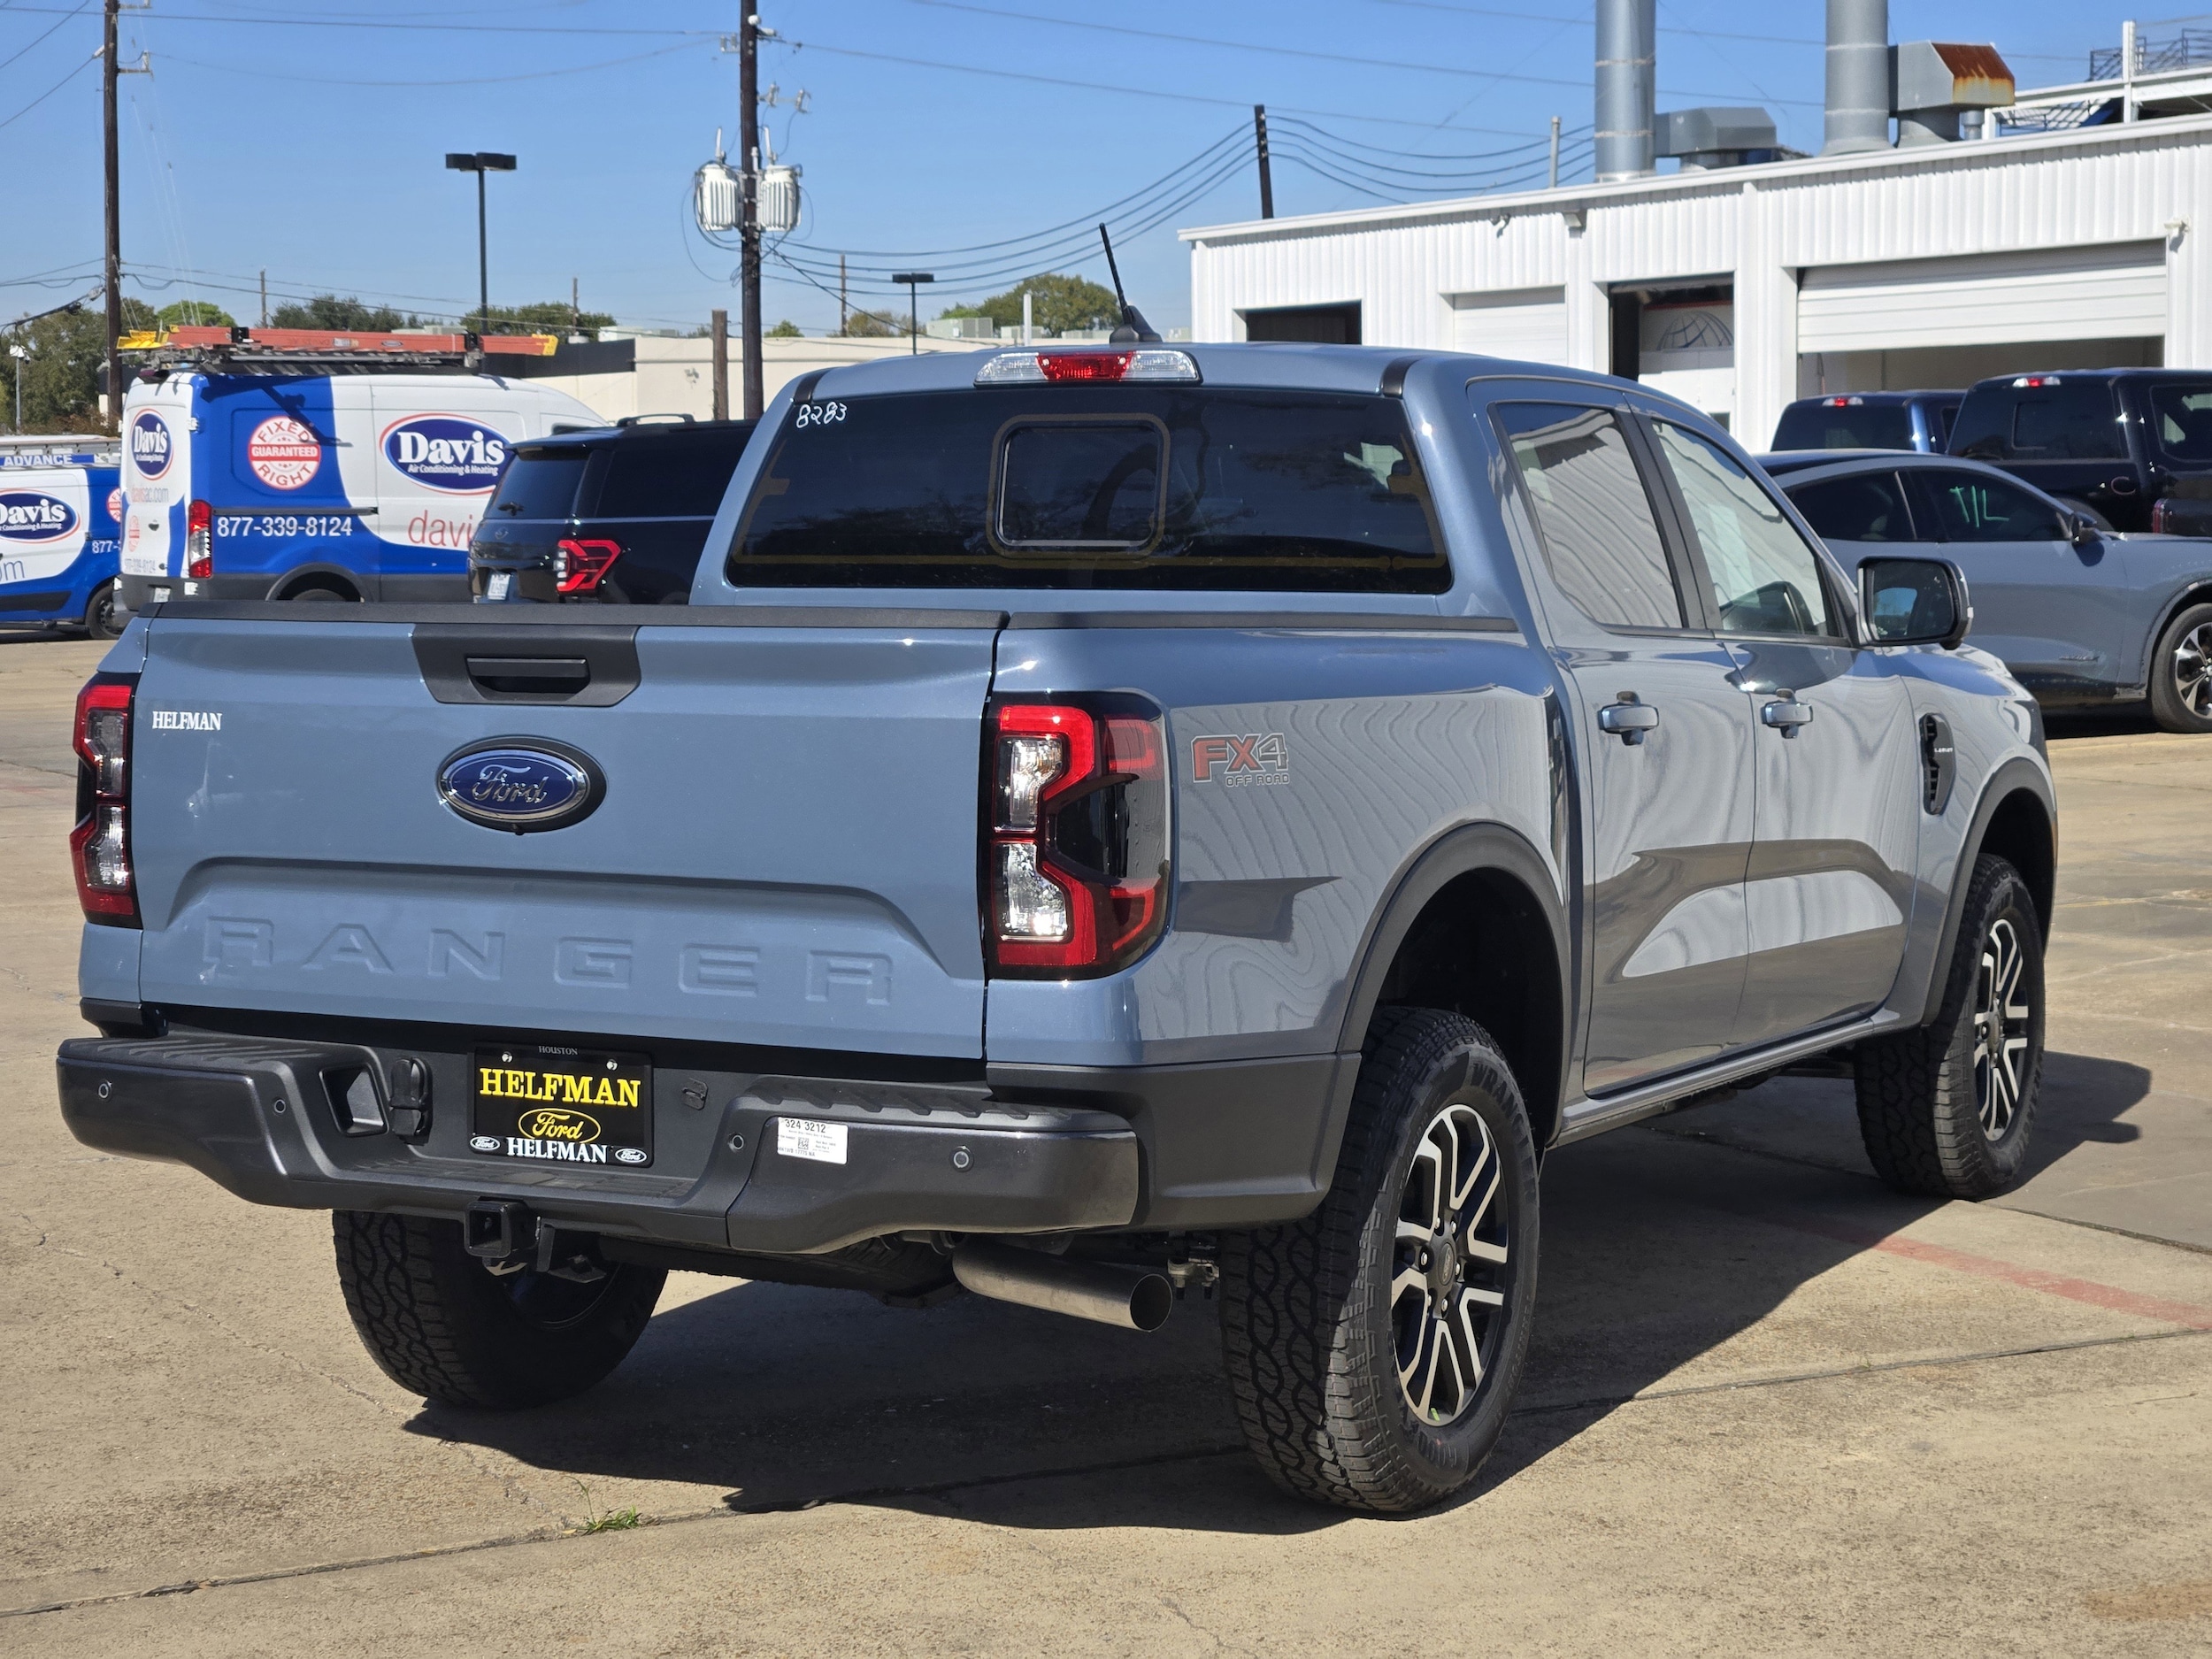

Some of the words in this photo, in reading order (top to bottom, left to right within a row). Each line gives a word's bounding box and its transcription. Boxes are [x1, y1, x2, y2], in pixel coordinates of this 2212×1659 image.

[796, 401, 848, 429] 8283
[134, 423, 168, 453] Davis
[257, 421, 310, 443] FIXED
[4, 454, 73, 466] ADVANCE
[252, 446, 319, 457] GUARANTEED
[397, 430, 505, 465] Davis
[258, 463, 312, 486] RIGHT
[217, 516, 353, 537] 877-339-8124
[152, 710, 223, 731] HELFMAN
[1191, 733, 1289, 783] FX4
[472, 764, 549, 804] Ford
[1225, 774, 1253, 787] OFF
[1256, 772, 1290, 786] ROAD
[203, 915, 894, 1006] RANGER
[538, 1045, 579, 1056] HOUSTON
[480, 1067, 641, 1108] HELFMAN
[532, 1111, 585, 1140] Ford
[785, 1119, 802, 1130] 324
[804, 1122, 826, 1133] 3212
[506, 1137, 609, 1164] HELFMAN
